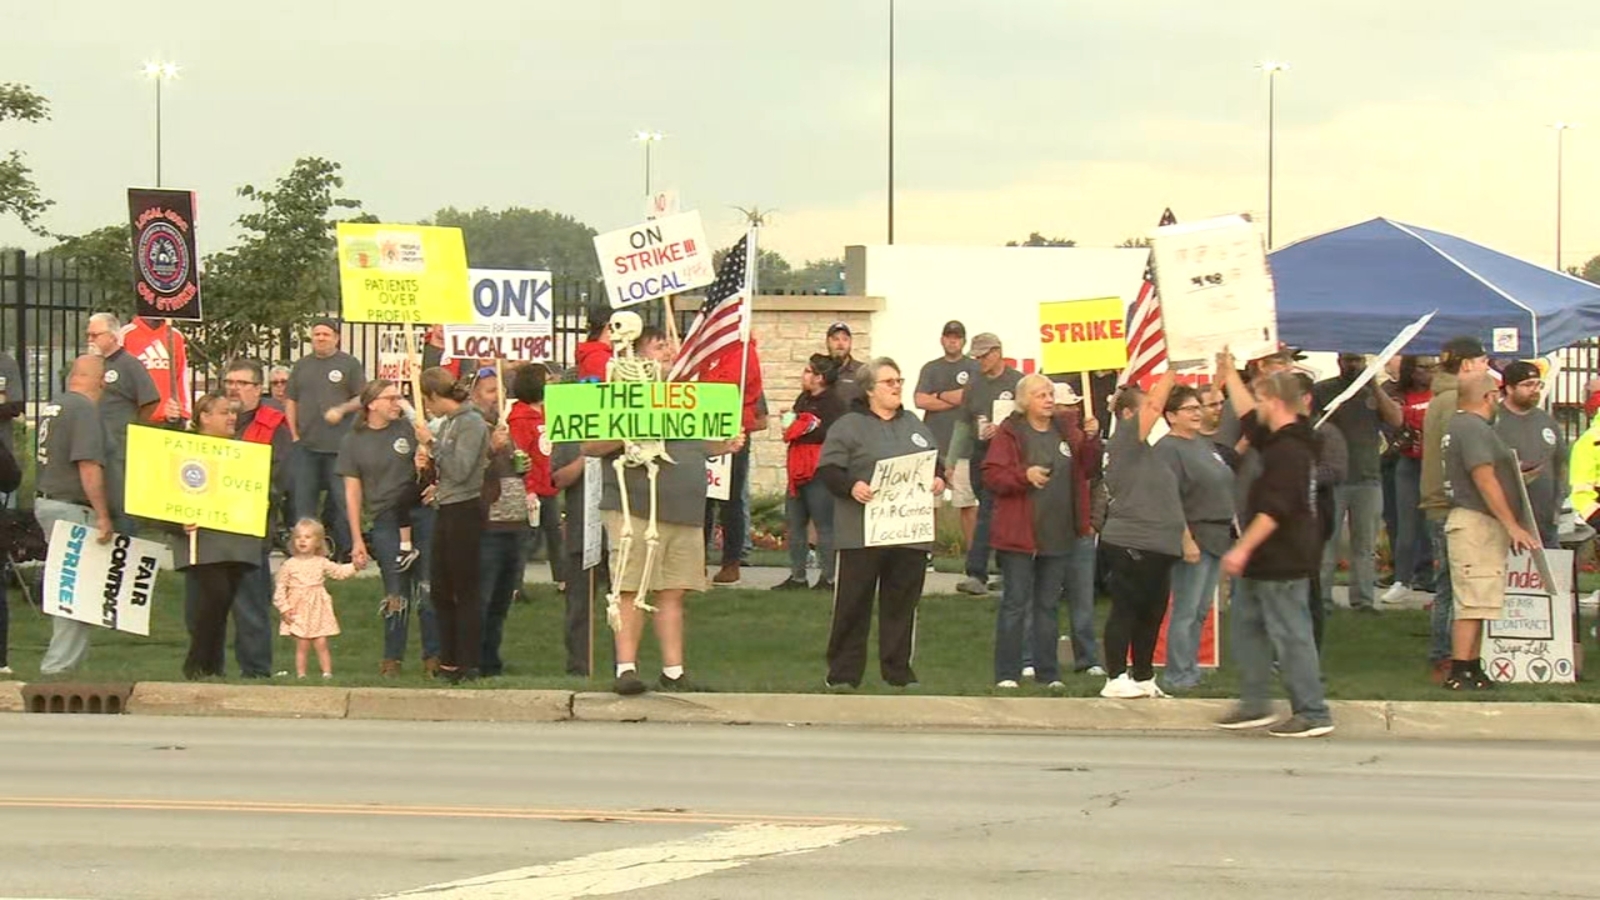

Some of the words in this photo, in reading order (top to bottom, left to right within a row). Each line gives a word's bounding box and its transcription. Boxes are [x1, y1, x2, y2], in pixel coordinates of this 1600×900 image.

[629, 225, 664, 250] ON
[364, 279, 419, 293] PATIENTS
[378, 291, 416, 306] OVER
[617, 271, 687, 302] LOCAL
[472, 278, 552, 322] ONK
[1040, 319, 1125, 344] STRIKE
[452, 335, 507, 359] LOCAL
[512, 335, 551, 360] 498C
[596, 384, 644, 409] THE
[651, 384, 697, 409] LIES
[550, 413, 600, 439] ARE
[609, 412, 696, 437] KILLING
[702, 412, 733, 437] ME
[164, 437, 241, 459] PATIENTS
[222, 475, 263, 493] OVER
[165, 502, 229, 524] PROFITS
[102, 535, 131, 630] CONTRACT
[130, 556, 157, 607] FAIR
